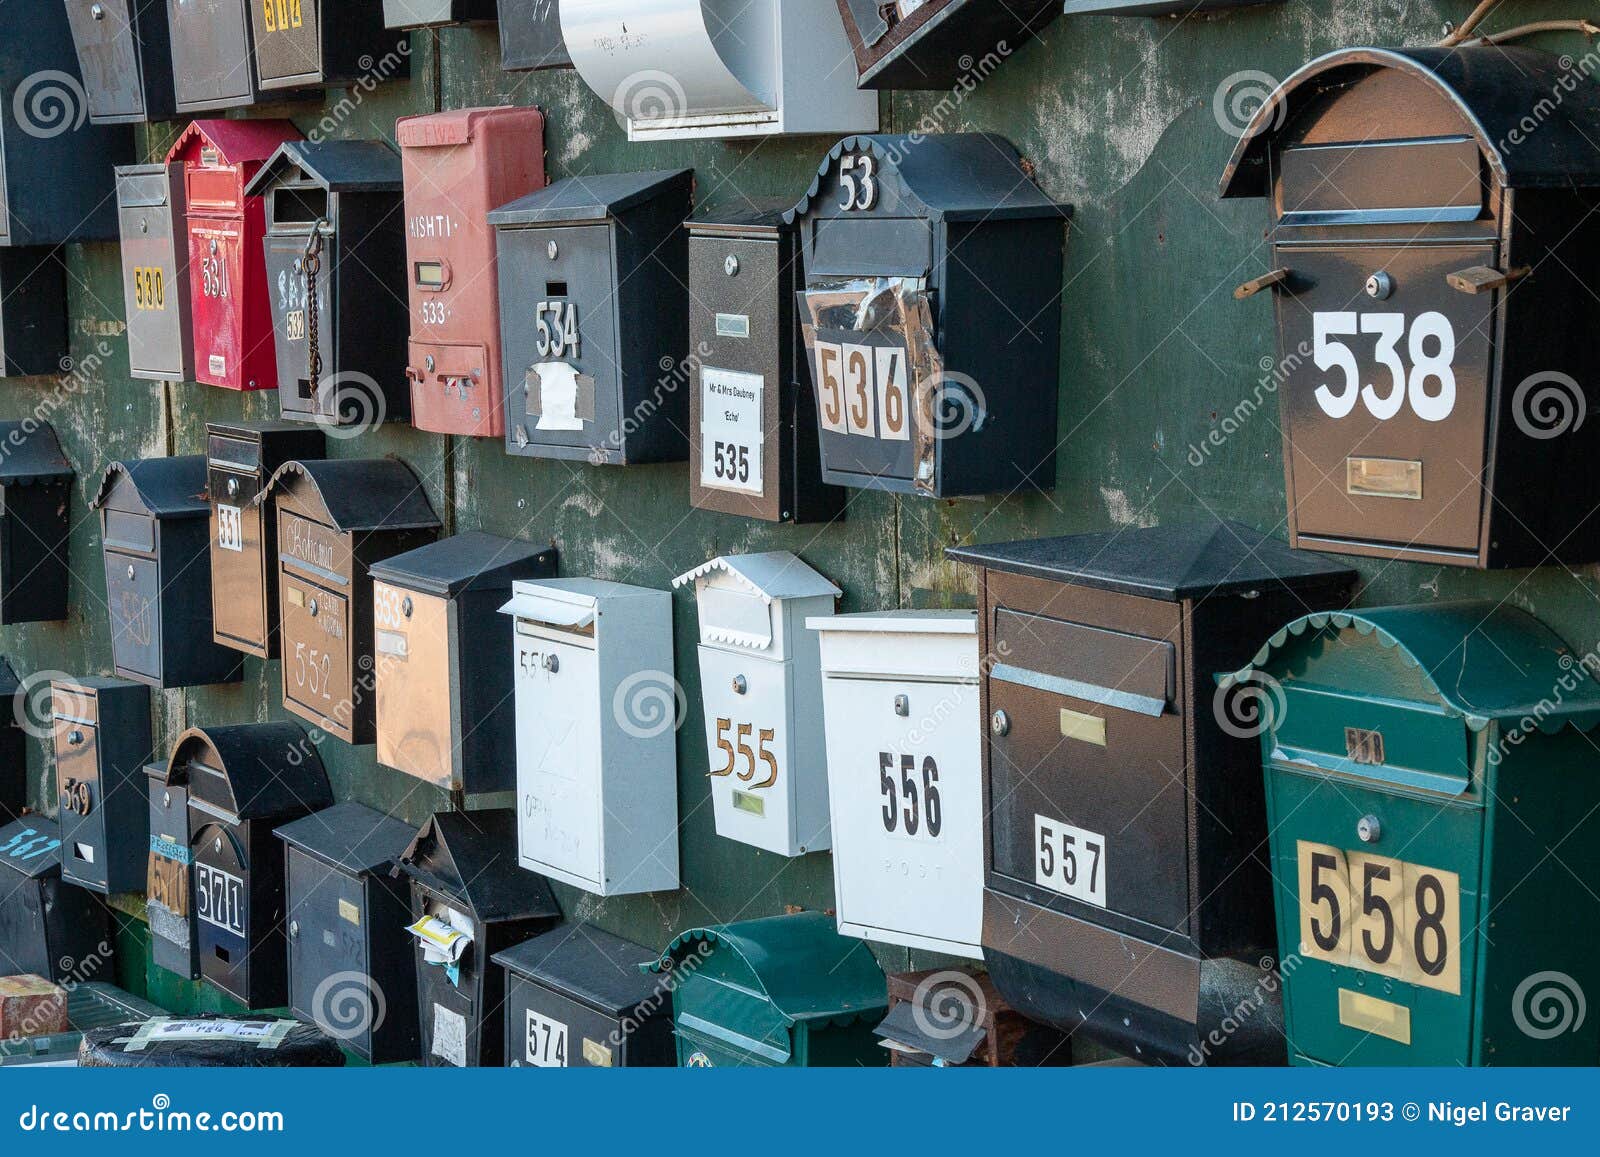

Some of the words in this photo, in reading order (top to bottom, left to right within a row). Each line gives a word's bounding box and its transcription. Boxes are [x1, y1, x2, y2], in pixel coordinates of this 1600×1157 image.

[839, 155, 877, 211] 53
[135, 271, 163, 306] 530
[203, 257, 228, 298] 531
[287, 312, 303, 339] 532
[422, 302, 446, 324] 533
[535, 301, 582, 359] 534
[709, 383, 716, 393] Mr
[722, 386, 733, 396] Mrs
[733, 387, 755, 402] Daubney
[820, 348, 902, 433] 536
[1312, 311, 1457, 422] 538
[714, 441, 749, 483] 535
[220, 509, 240, 547] 551
[375, 585, 400, 629] 553
[296, 642, 331, 700] 552
[705, 717, 778, 790] 555
[64, 777, 90, 816] 569
[879, 752, 942, 837] 556
[1039, 826, 1101, 894] 557
[199, 870, 241, 928] 571
[1310, 852, 1448, 976] 558
[528, 1017, 566, 1067] 574
